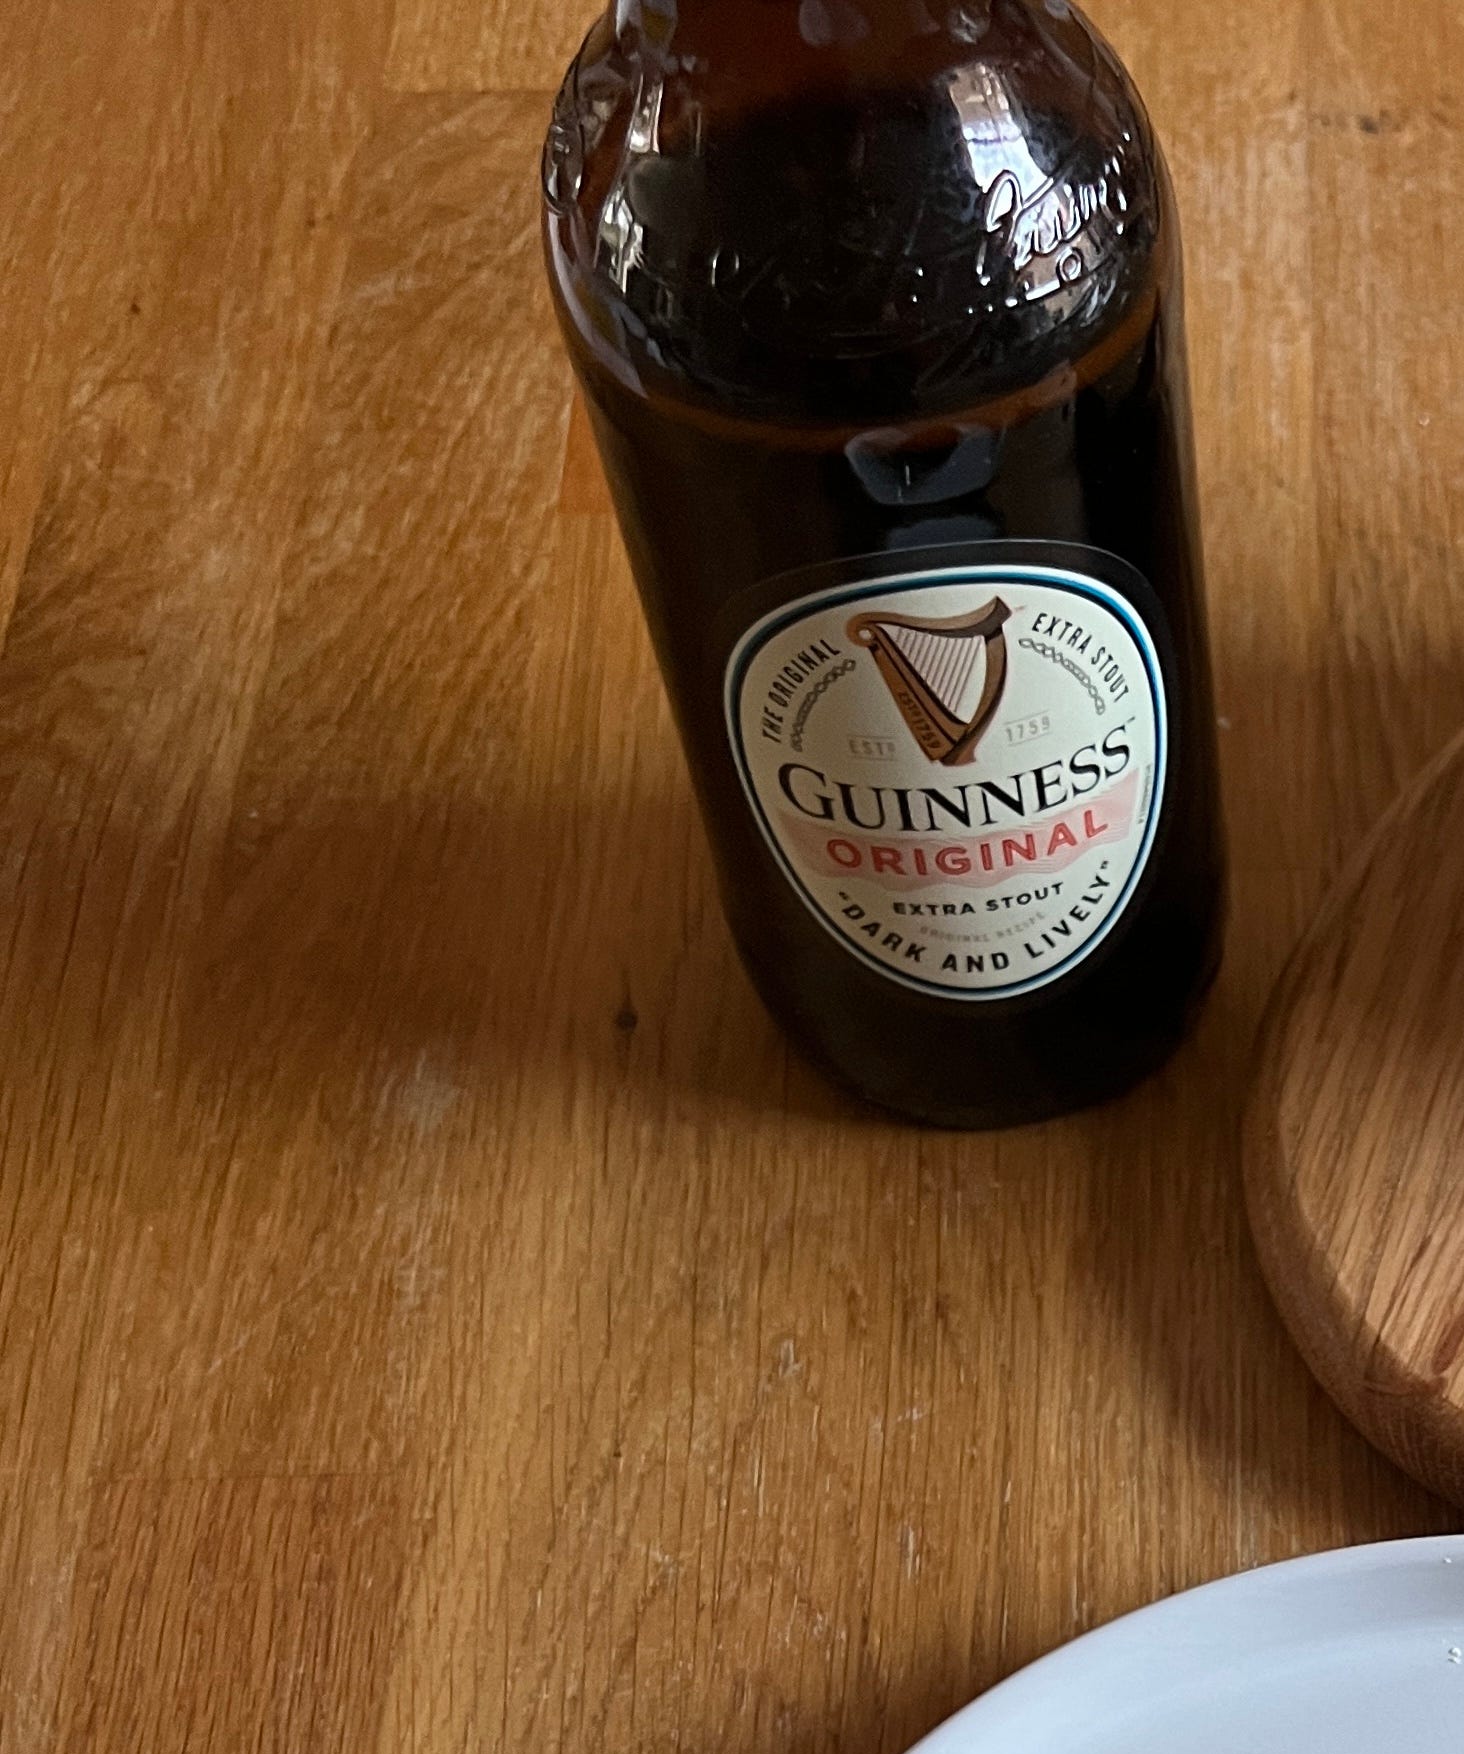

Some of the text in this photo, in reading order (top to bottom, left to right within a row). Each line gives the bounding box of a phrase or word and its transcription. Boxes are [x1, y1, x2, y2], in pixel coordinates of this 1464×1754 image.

[762, 639, 841, 743] THE ORIGINAL
[1032, 612, 1129, 703] EXTRA STOUT
[1005, 715, 1050, 743] 1759
[777, 723, 1130, 832] GUINNESS
[826, 809, 1109, 876] ORIGINAL
[893, 881, 1064, 916] EXTRA STOUT
[942, 952, 1010, 973] AND
